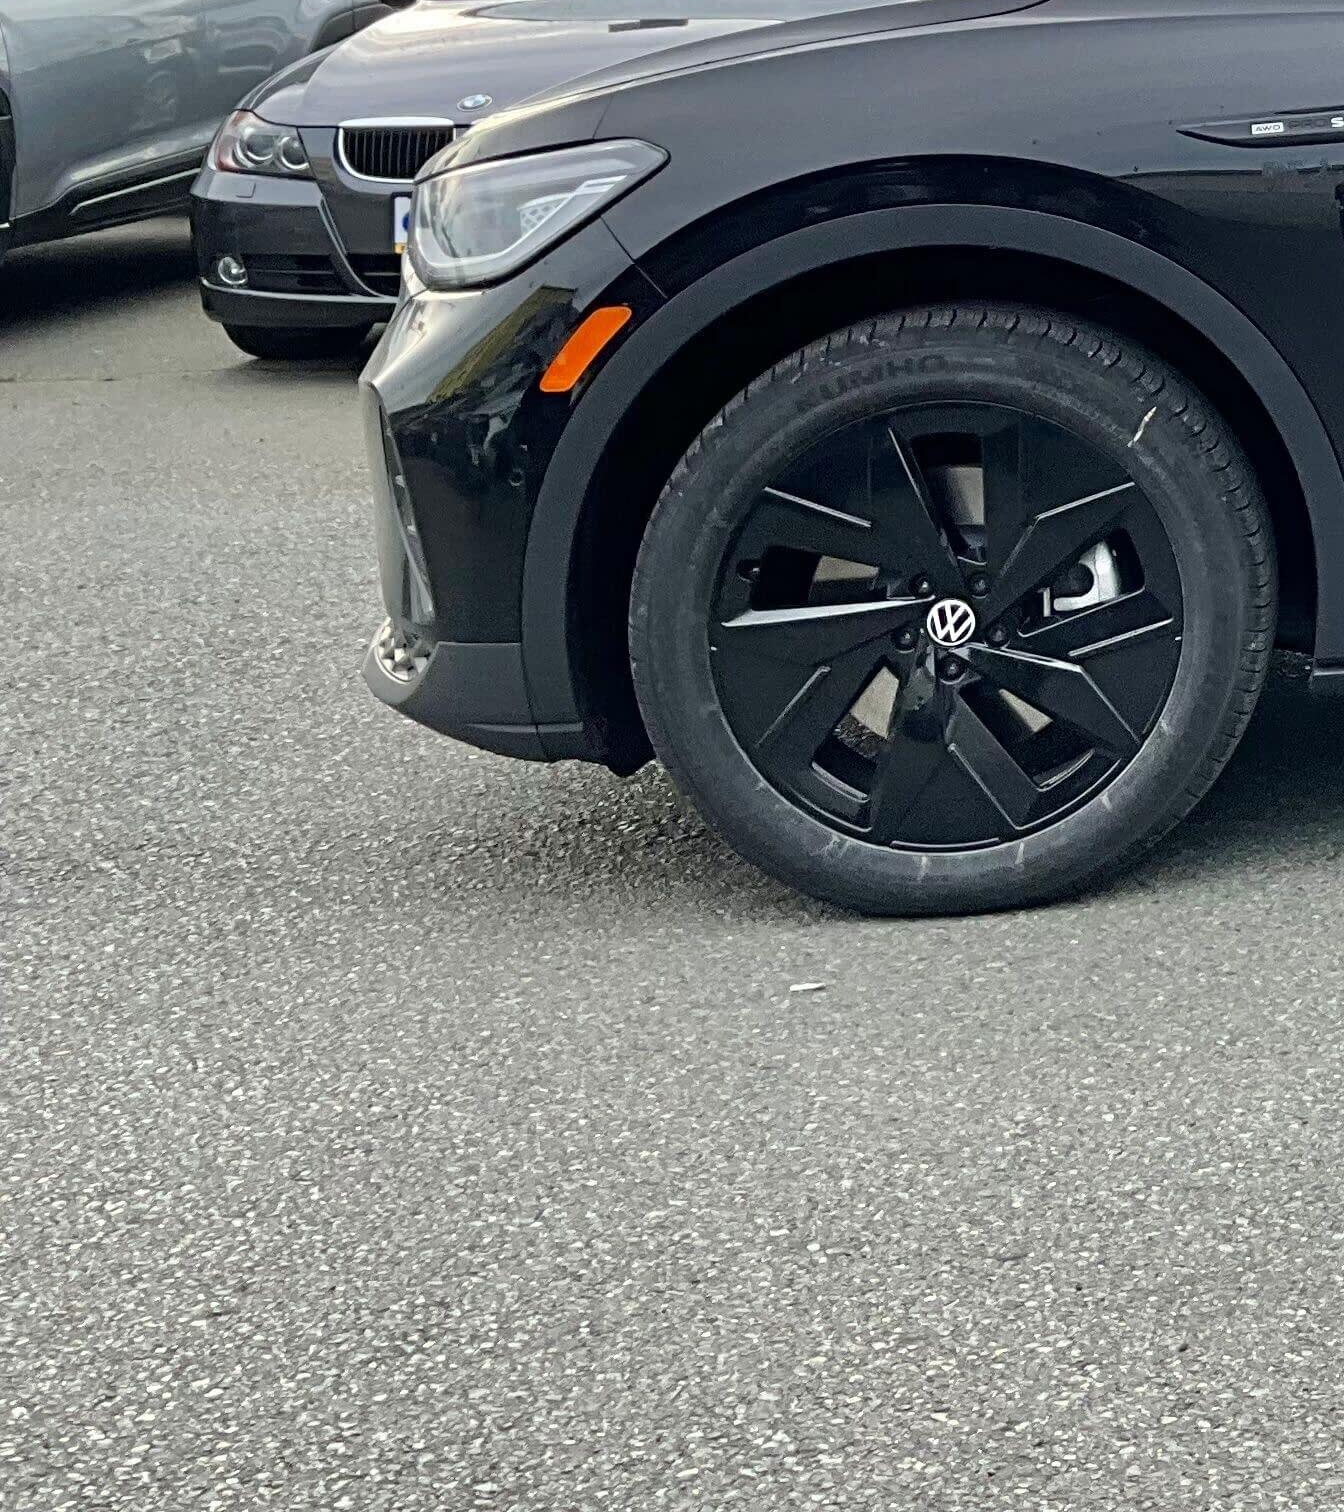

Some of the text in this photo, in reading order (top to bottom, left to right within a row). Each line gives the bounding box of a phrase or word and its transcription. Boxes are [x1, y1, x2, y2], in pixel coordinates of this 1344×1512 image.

[1253, 123, 1282, 133] AWD
[1330, 116, 1344, 128] S
[926, 599, 976, 646] VW
